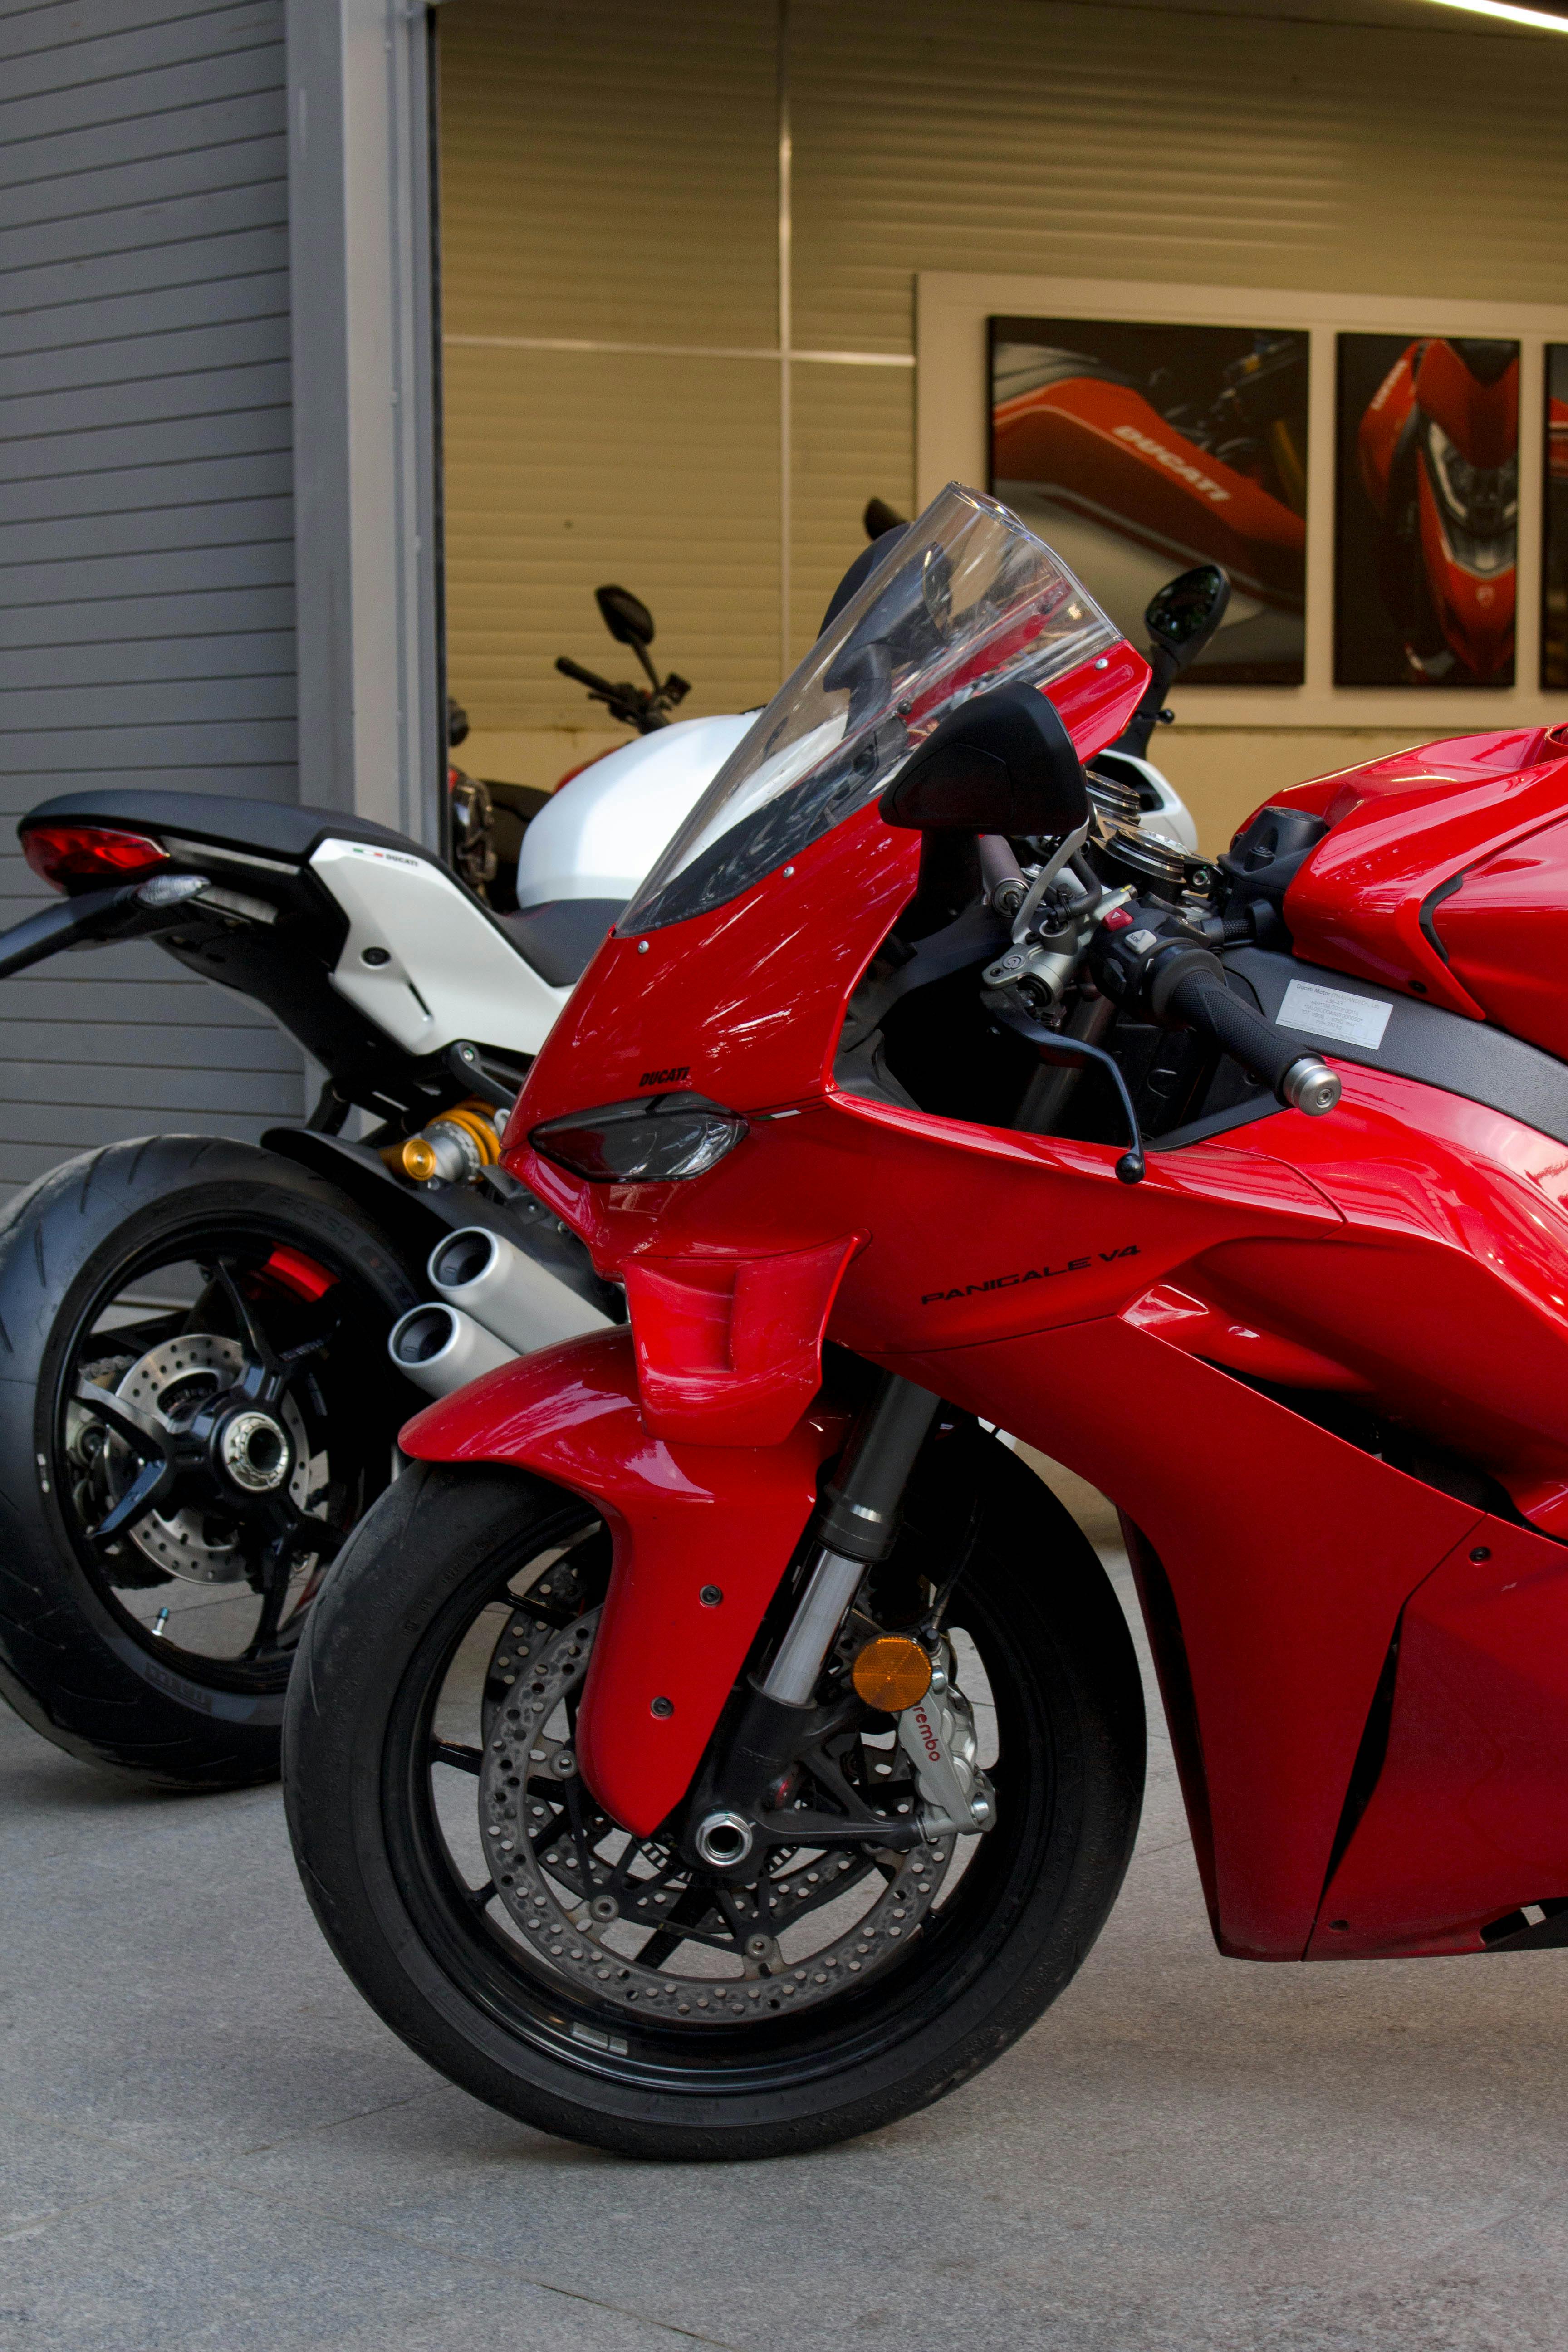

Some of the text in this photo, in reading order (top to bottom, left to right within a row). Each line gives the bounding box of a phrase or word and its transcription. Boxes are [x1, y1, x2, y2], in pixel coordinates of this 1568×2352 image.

[1113, 426, 1231, 502] DUCATI
[386, 854, 418, 867] DUCATI
[1296, 983, 1314, 992] Ducati
[1313, 988, 1331, 996] Motor
[1330, 992, 1361, 1004] (THALAND)
[639, 1067, 690, 1087] DUCATI
[921, 1245, 1141, 1305] PANIGALE V4
[912, 1701, 941, 1762] rembo
